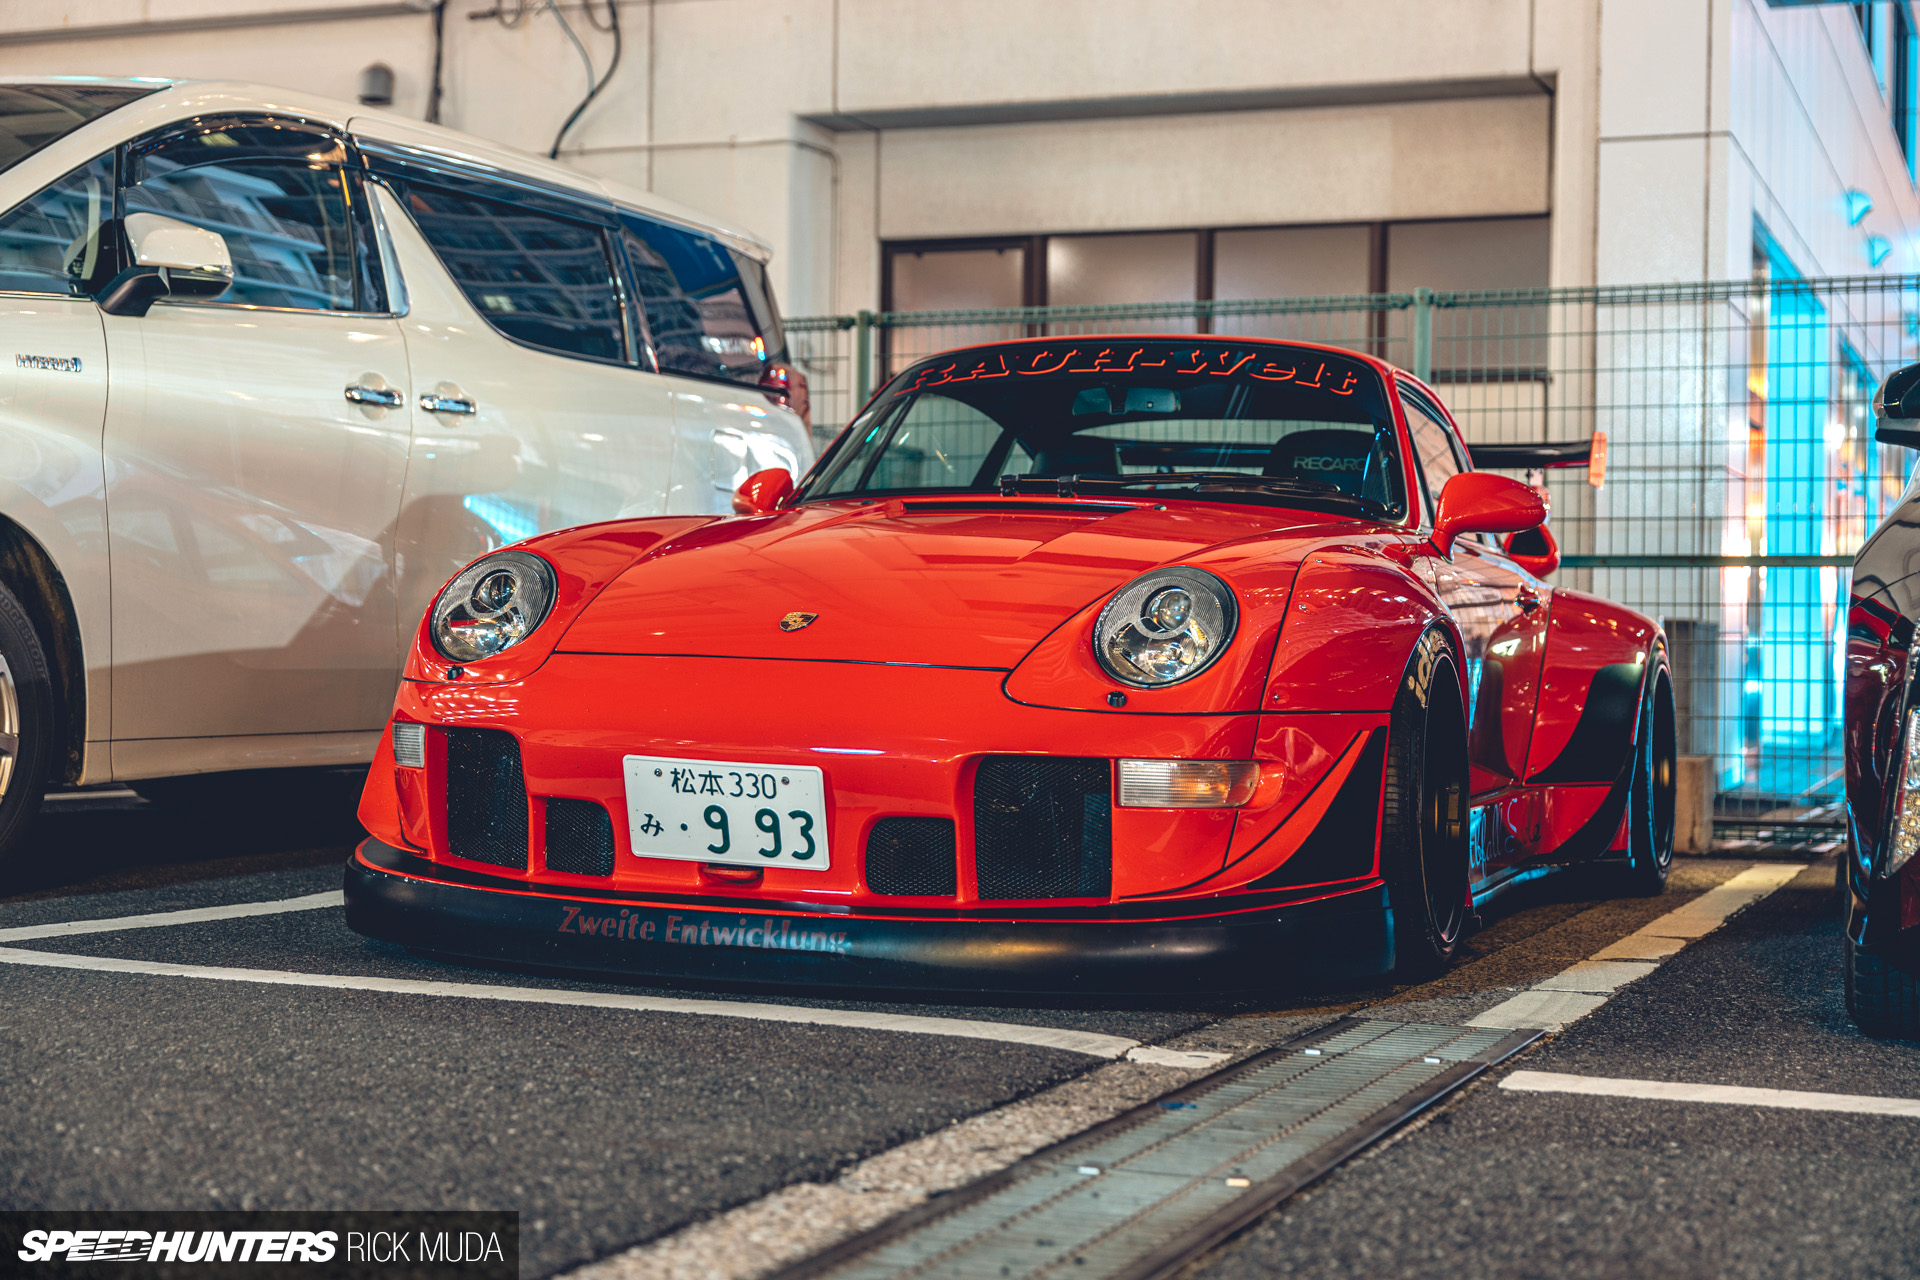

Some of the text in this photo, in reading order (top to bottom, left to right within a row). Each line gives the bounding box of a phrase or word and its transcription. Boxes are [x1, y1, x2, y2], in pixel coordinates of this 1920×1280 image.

[640, 812, 665, 837] み
[557, 905, 848, 957] Zweite Entwicklung
